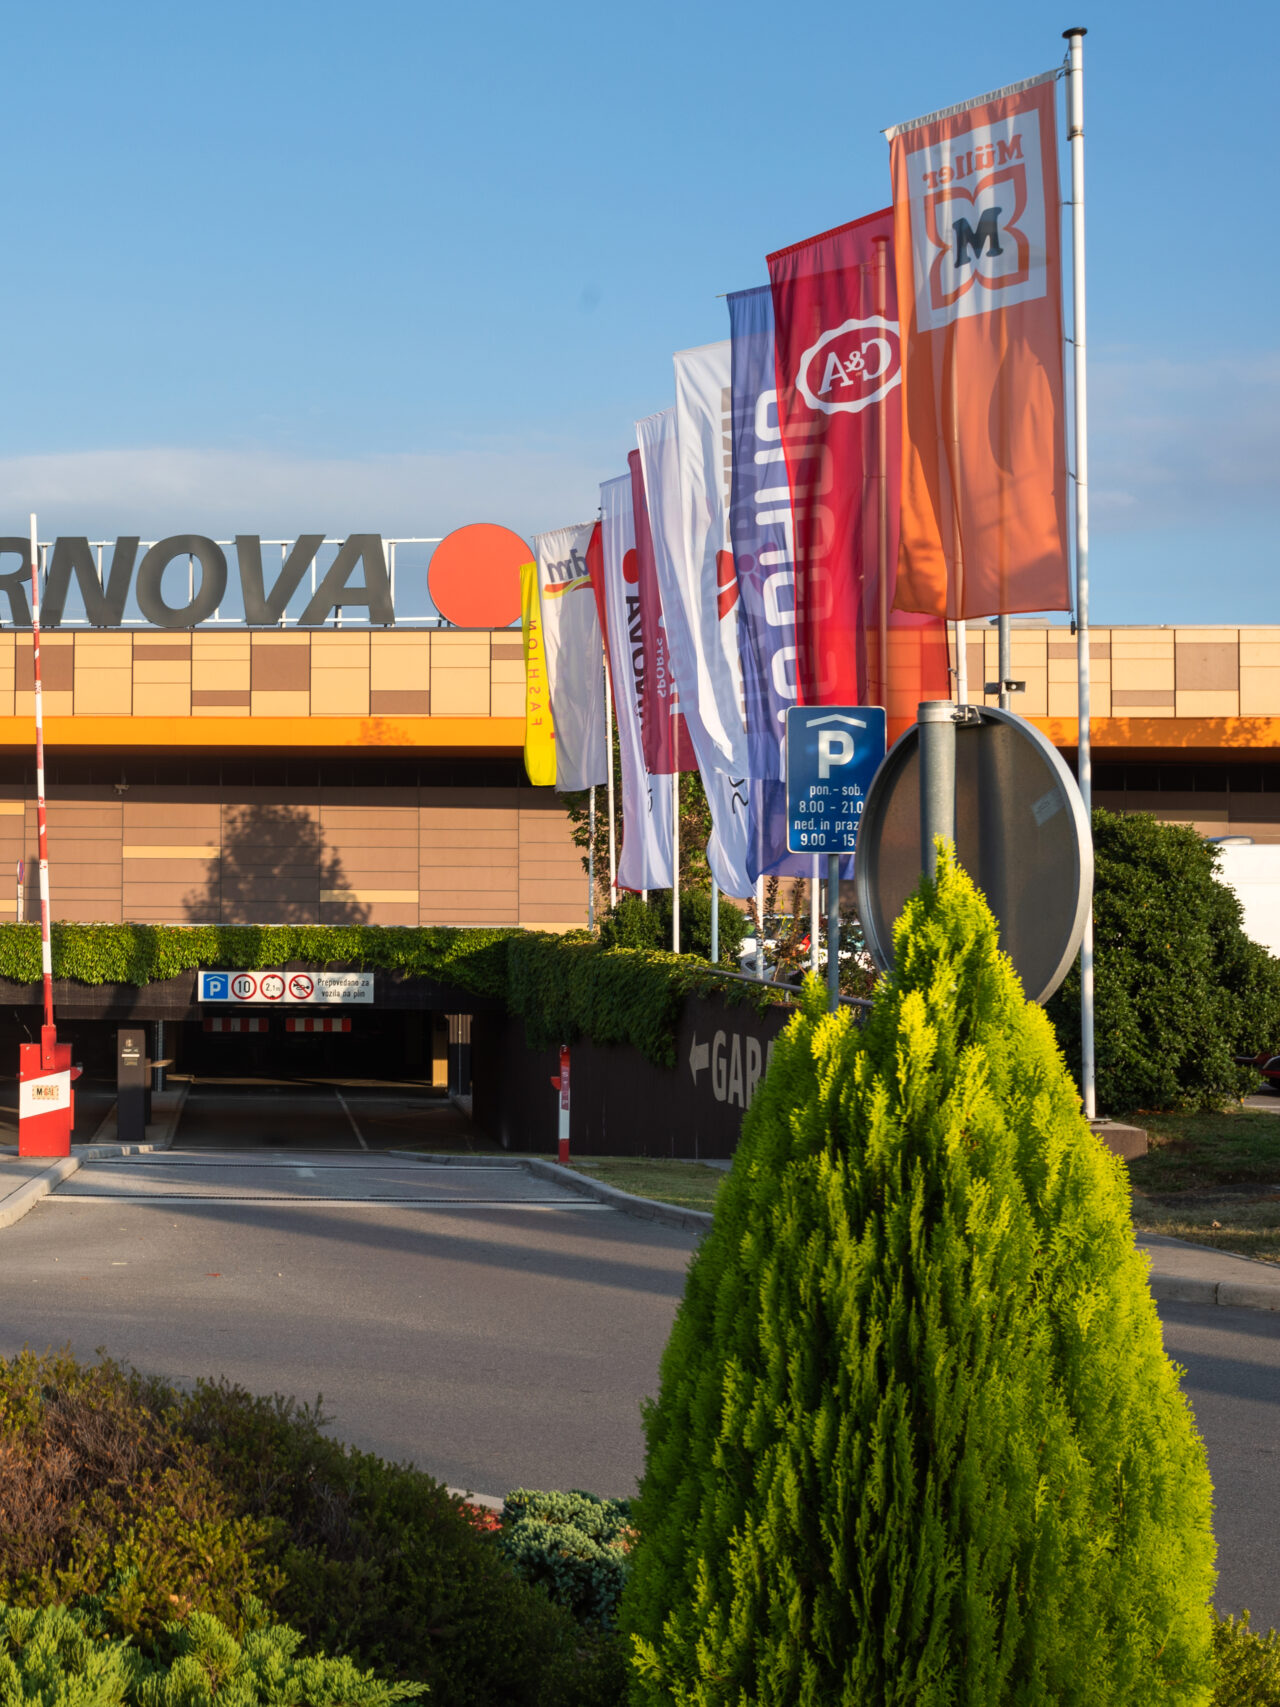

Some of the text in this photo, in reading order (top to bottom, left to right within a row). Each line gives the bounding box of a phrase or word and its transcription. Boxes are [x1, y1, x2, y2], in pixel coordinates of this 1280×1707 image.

[952, 206, 1004, 269] M
[819, 731, 855, 778] P
[809, 785, 832, 799] pon.
[841, 783, 864, 796] sob.
[799, 800, 825, 813] 8.00
[794, 818, 817, 831] ned.
[820, 818, 830, 831] in
[800, 833, 826, 846] 9.00
[210, 981, 222, 997] P
[237, 980, 251, 994] 10
[317, 978, 370, 987] Prepovedano za
[321, 989, 340, 998] vozila
[353, 990, 366, 999] plin
[711, 1030, 775, 1110] GAR
